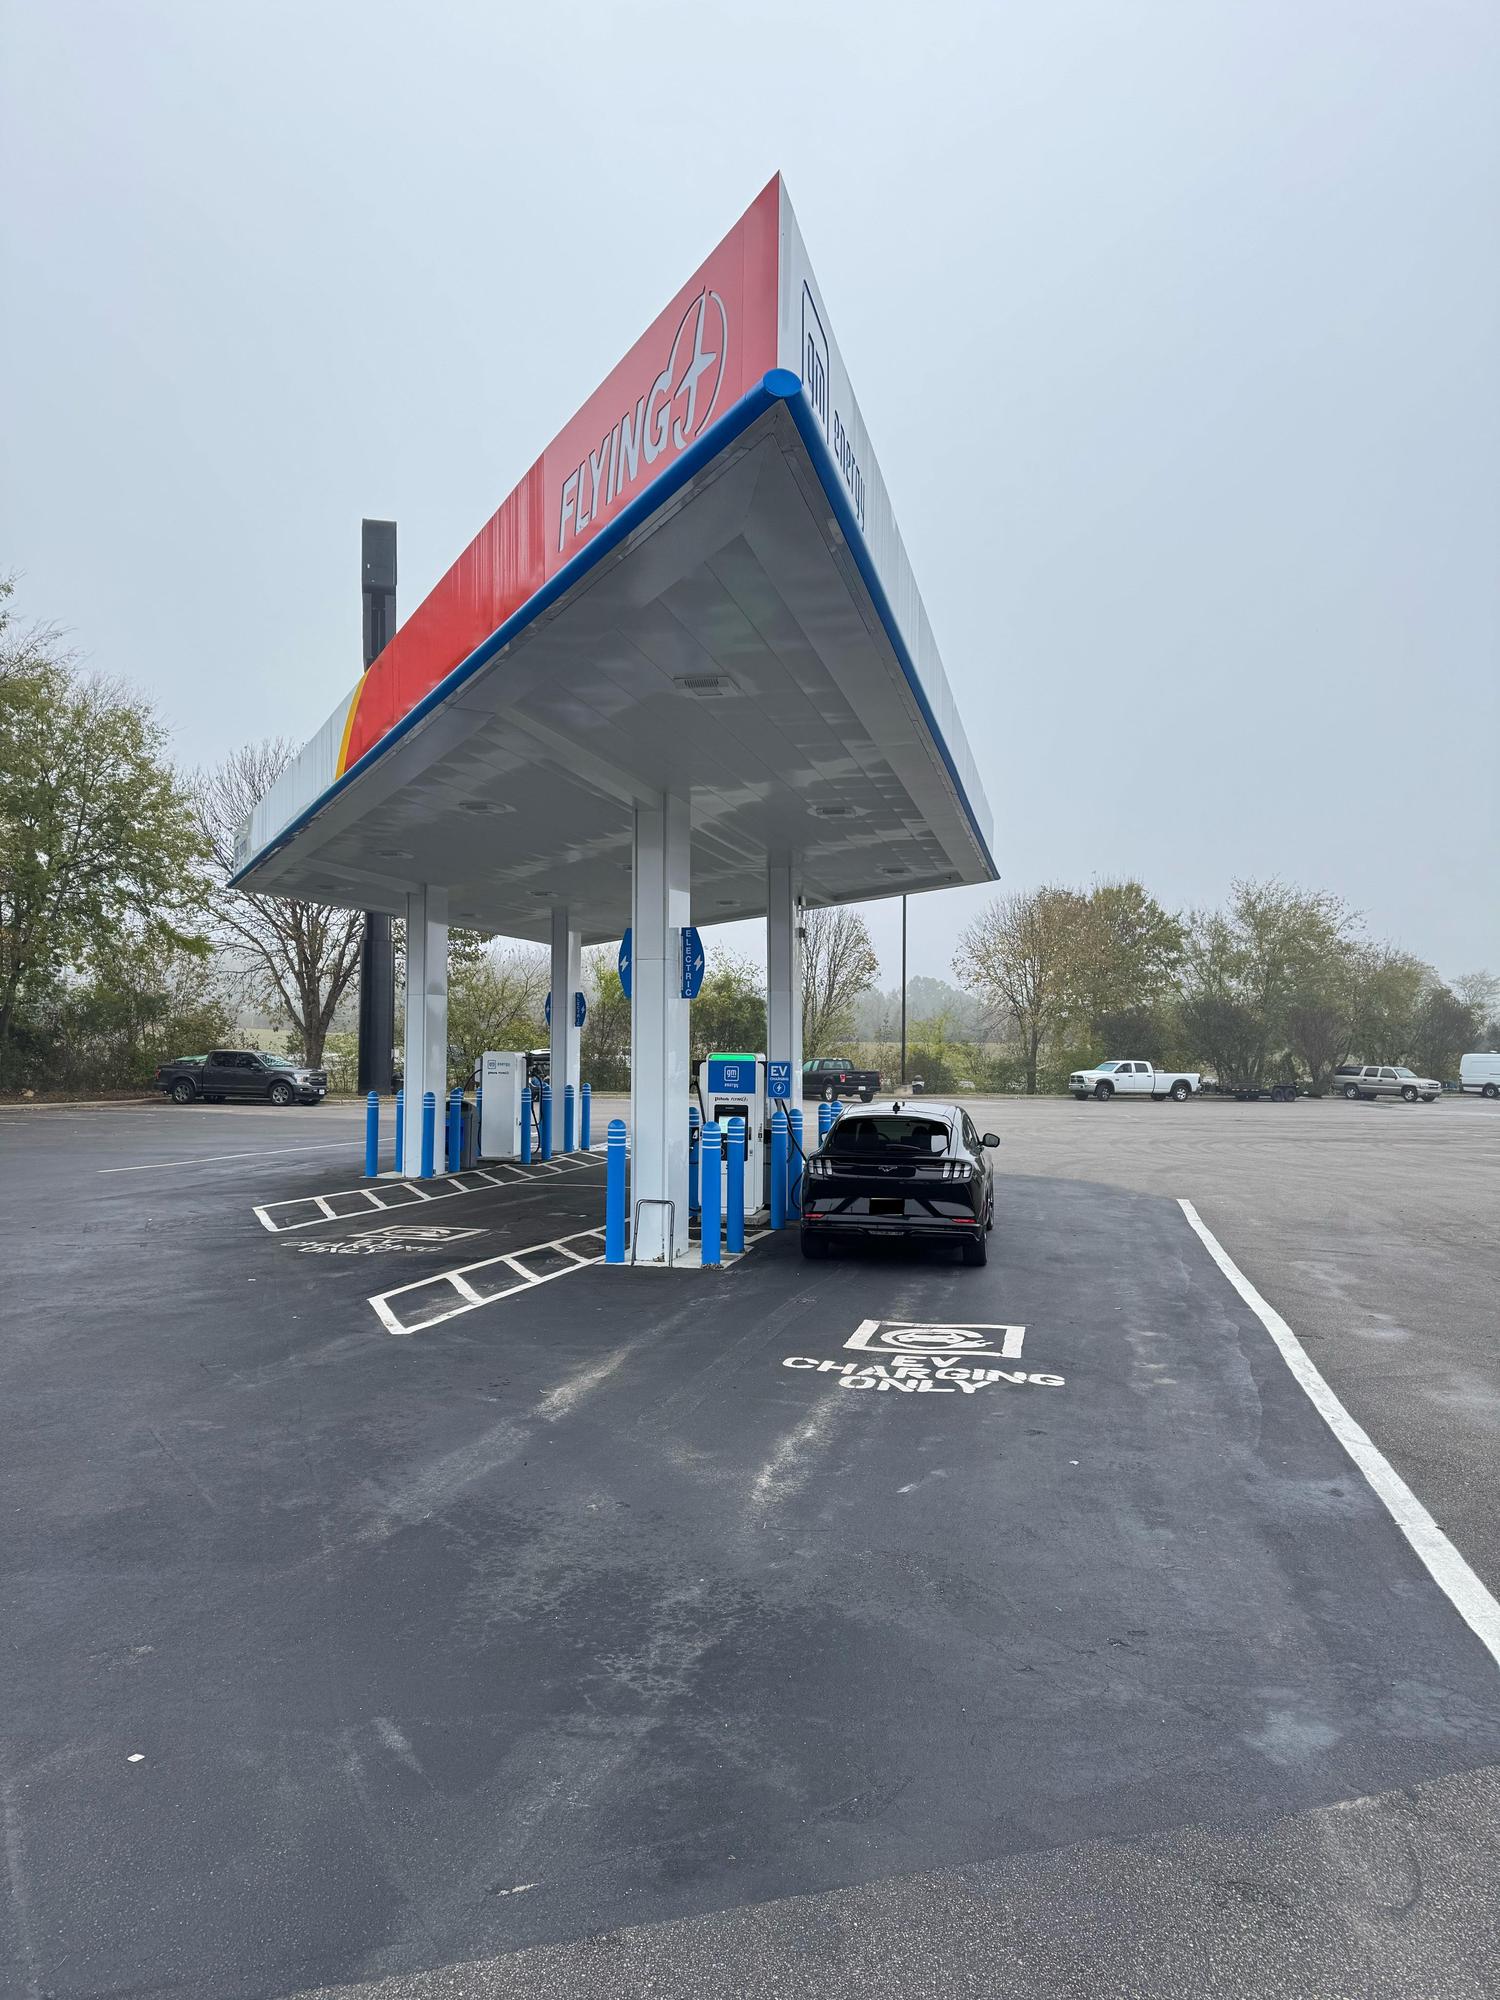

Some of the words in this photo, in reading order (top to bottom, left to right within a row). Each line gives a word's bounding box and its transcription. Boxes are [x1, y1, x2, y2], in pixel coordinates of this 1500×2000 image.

[558, 368, 672, 553] FLYING
[833, 409, 866, 532] energy
[770, 1065, 788, 1077] EV
[782, 1356, 1066, 1387] CHARGING
[890, 1355, 962, 1367] EV
[838, 1375, 993, 1394] ONLY
